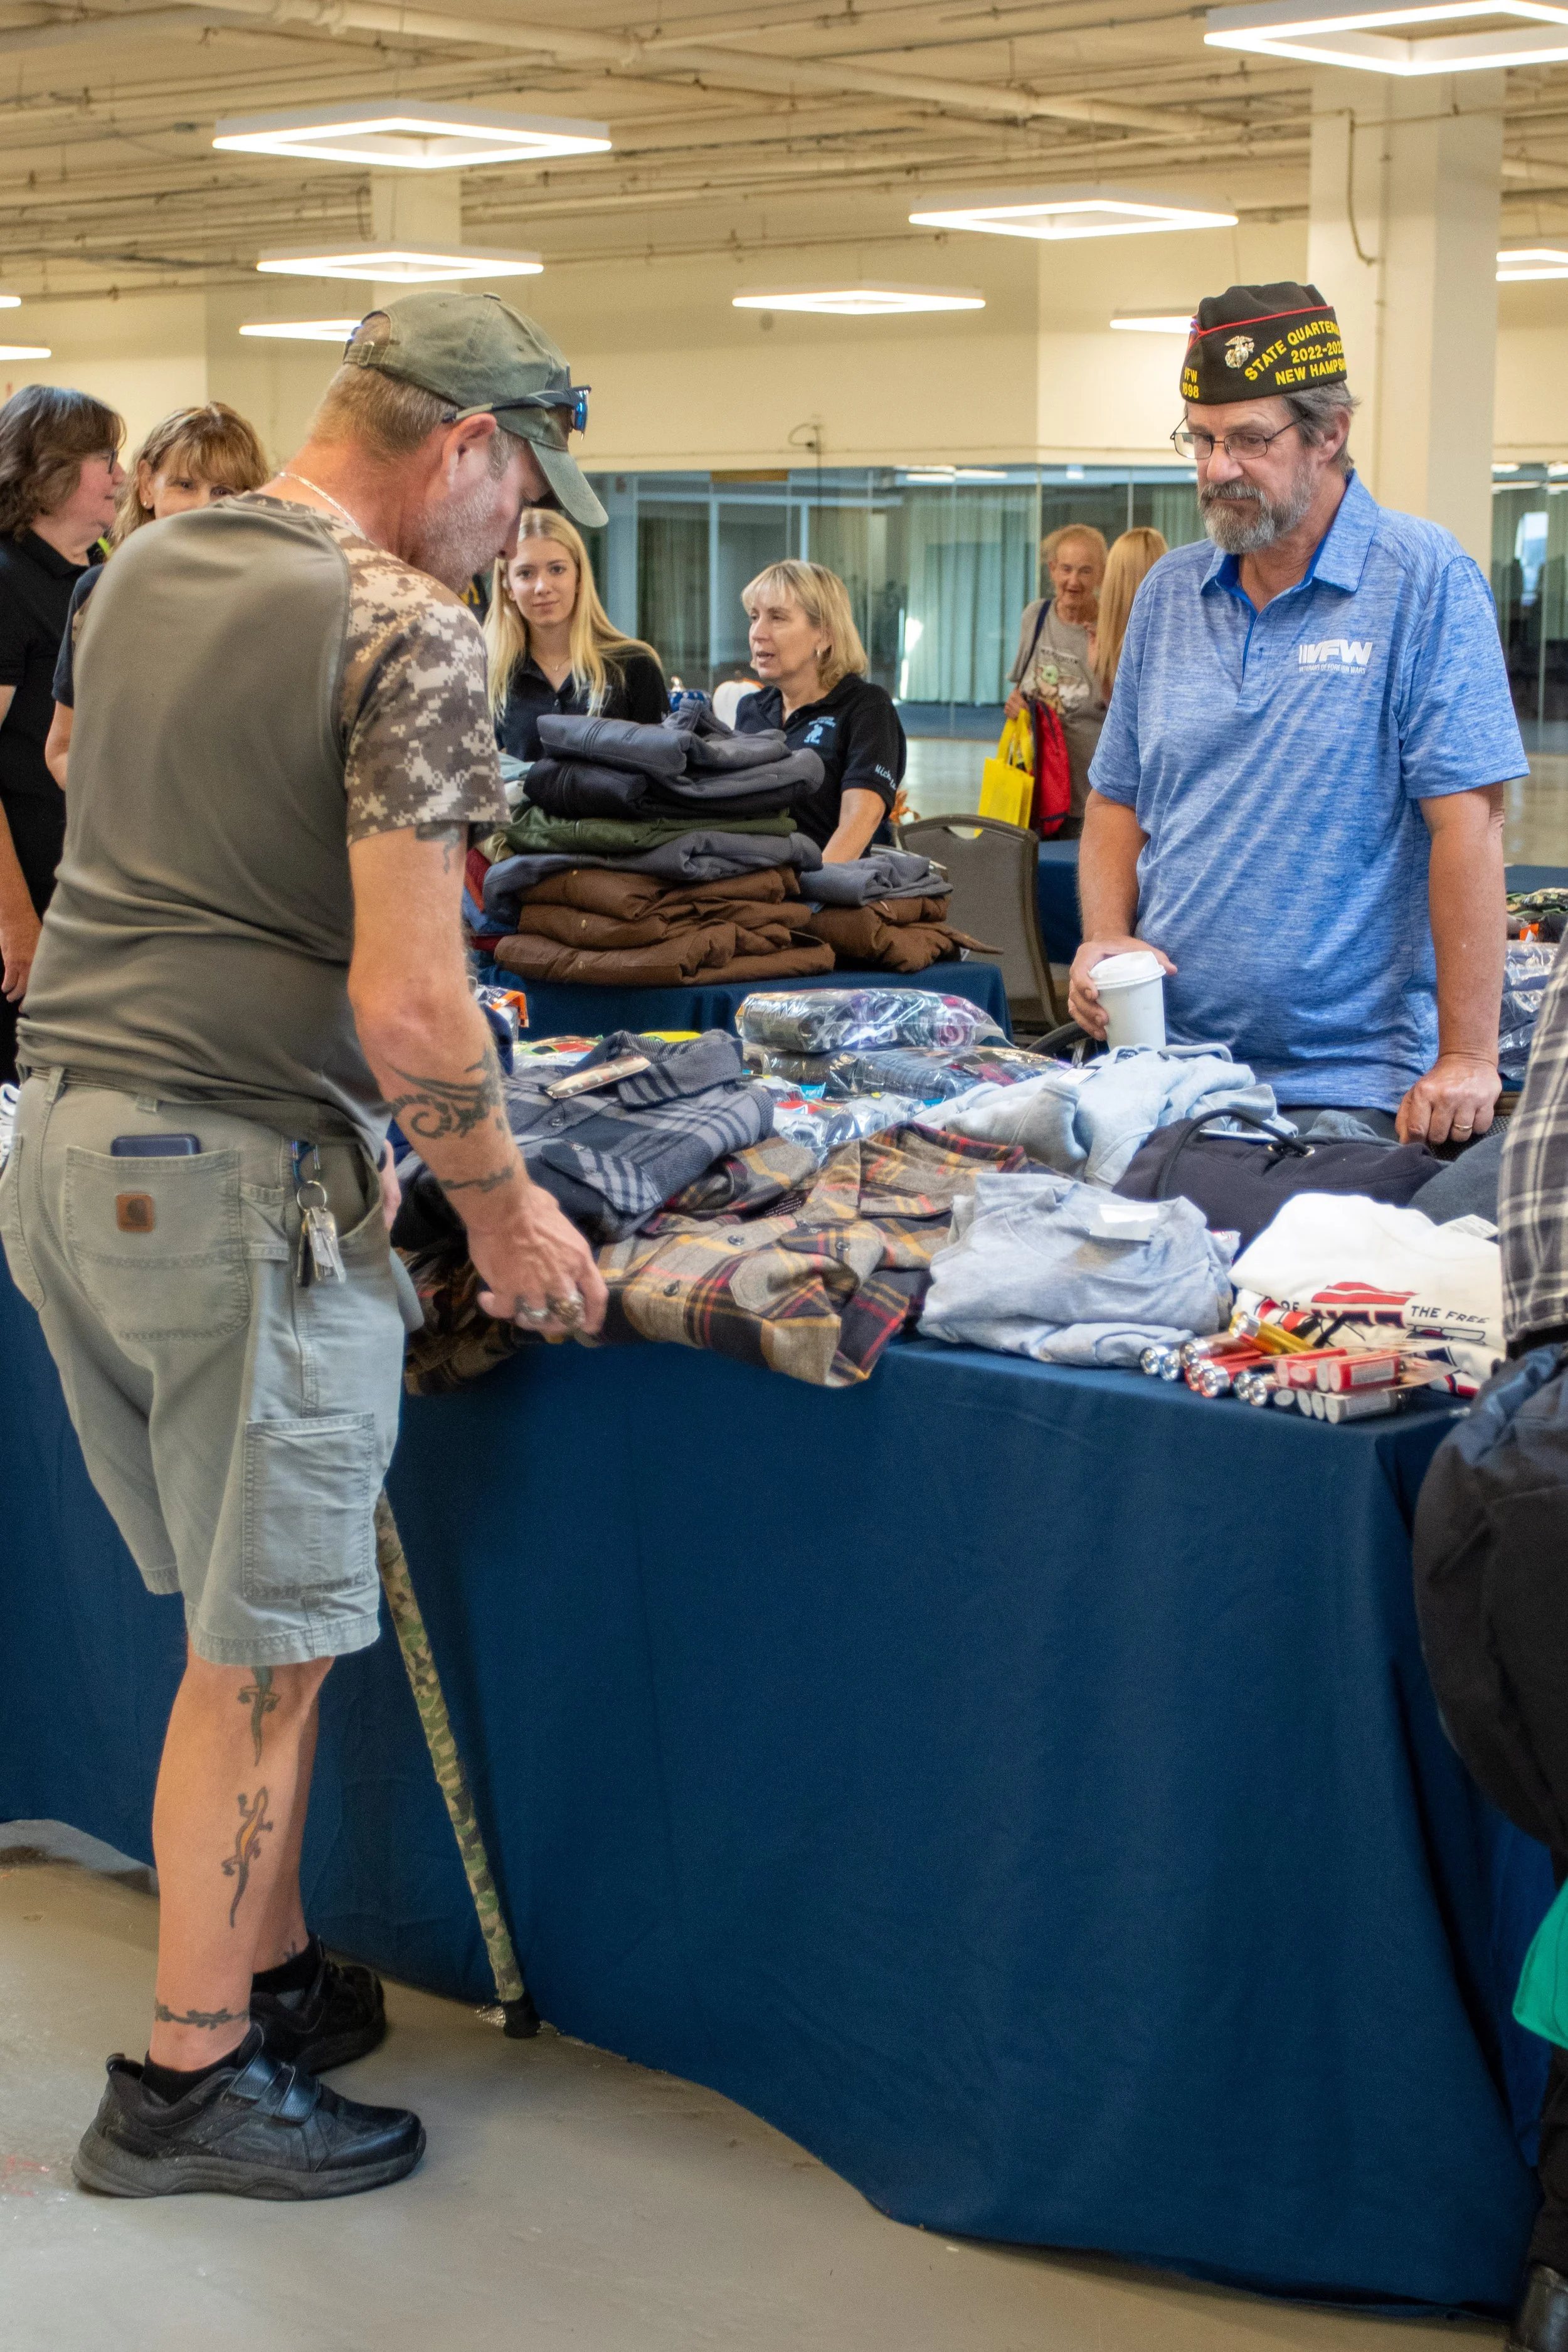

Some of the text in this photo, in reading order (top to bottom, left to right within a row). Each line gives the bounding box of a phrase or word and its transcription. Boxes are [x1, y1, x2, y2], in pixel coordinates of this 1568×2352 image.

[1244, 340, 1286, 381] STATE
[1275, 366, 1306, 385] NEW
[1182, 381, 1199, 399] 1898
[1299, 638, 1373, 665] VFW
[1328, 663, 1350, 674] FOREIGN
[1350, 665, 1366, 675] WARS
[1411, 1305, 1441, 1318] THE
[1445, 1310, 1490, 1323] FREE
